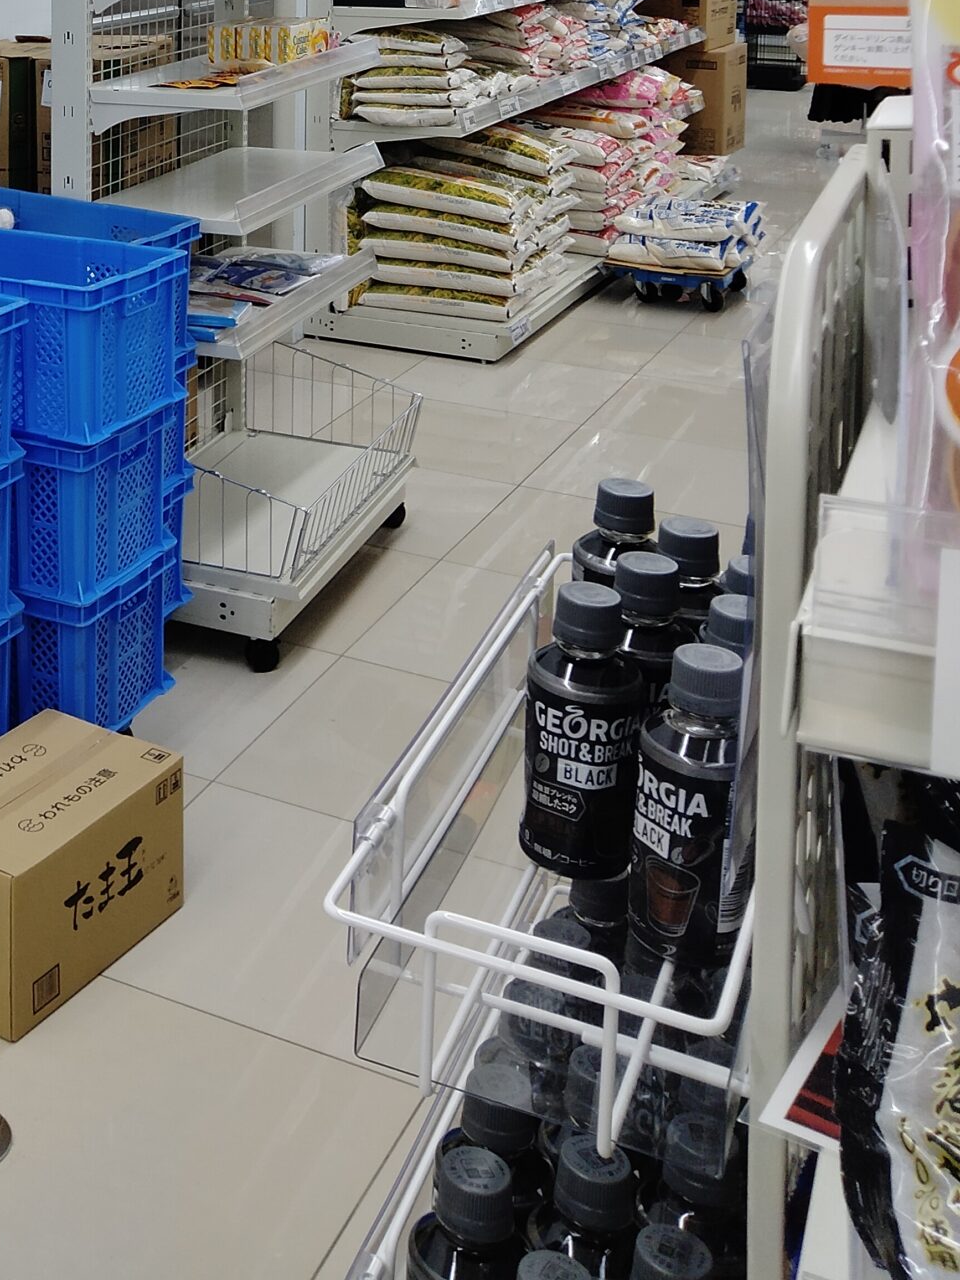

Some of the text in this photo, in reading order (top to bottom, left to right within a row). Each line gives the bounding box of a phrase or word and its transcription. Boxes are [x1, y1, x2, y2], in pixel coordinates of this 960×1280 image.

[534, 700, 641, 743] GEORGIA
[539, 731, 633, 764] SHOT&BREAK
[563, 763, 614, 786] BLACK
[38, 768, 119, 821] われもの注意
